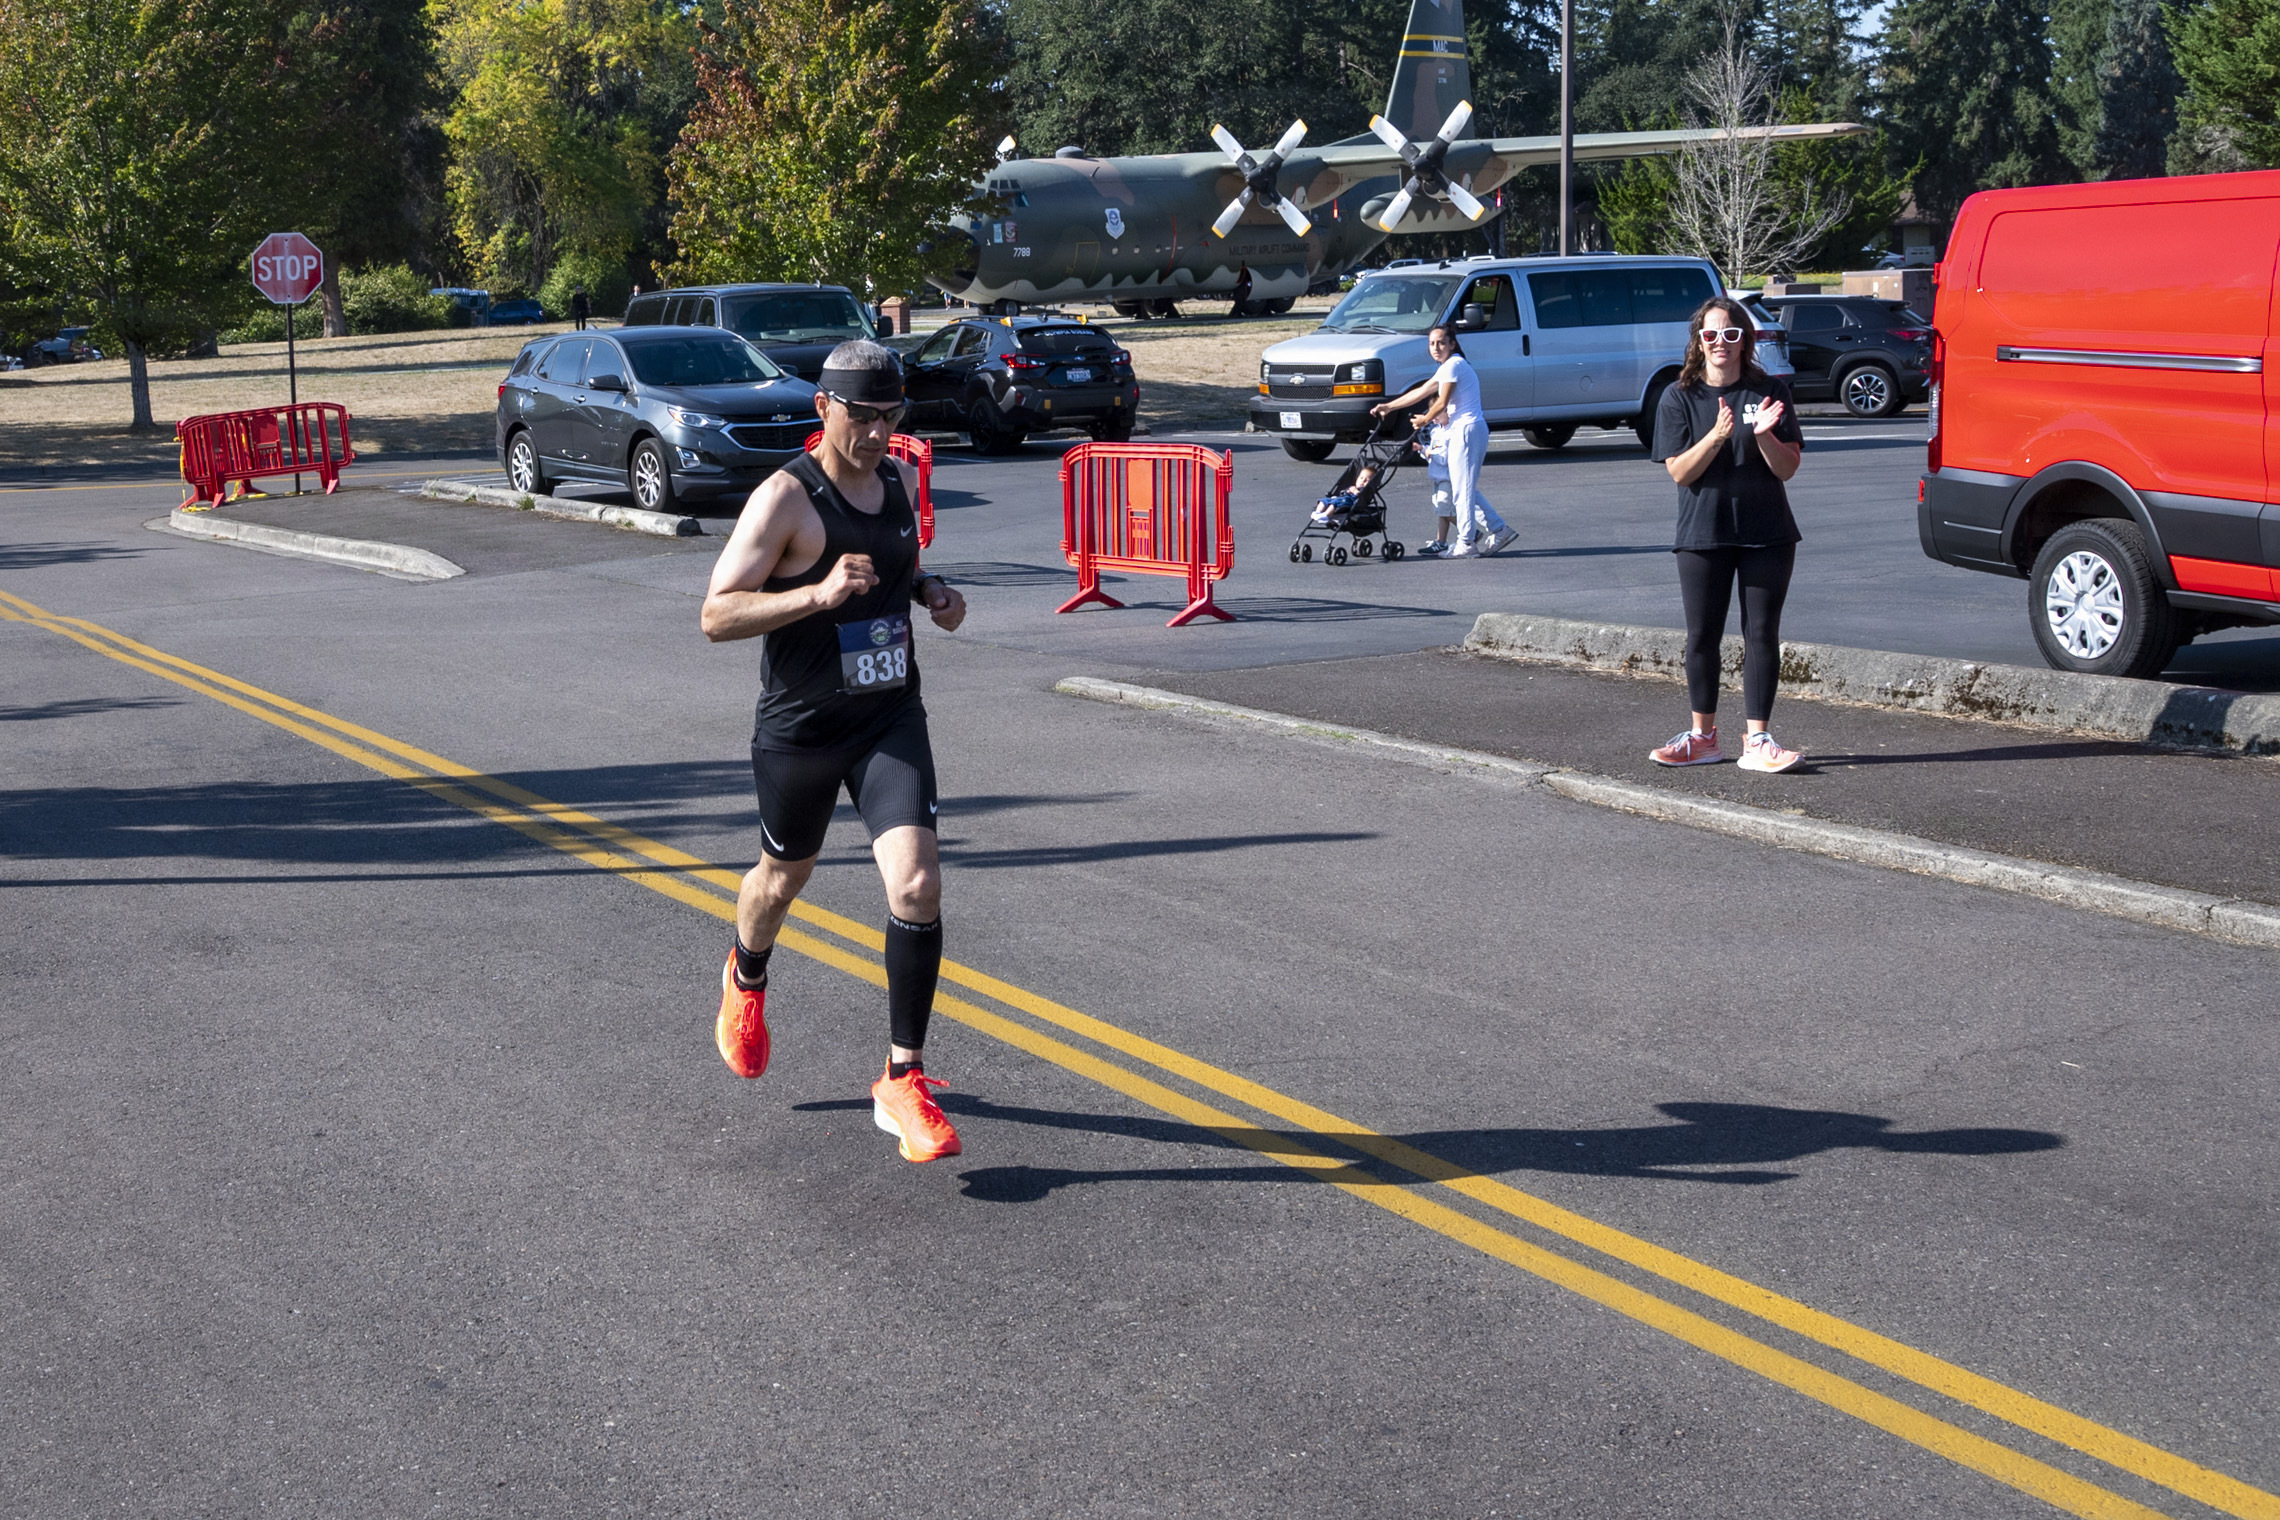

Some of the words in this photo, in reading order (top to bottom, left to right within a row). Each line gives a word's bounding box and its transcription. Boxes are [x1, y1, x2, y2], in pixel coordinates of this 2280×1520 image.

[1432, 39, 1449, 53] MAC
[1013, 247, 1031, 258] 7788
[257, 254, 318, 282] STOP
[856, 647, 907, 685] 838
